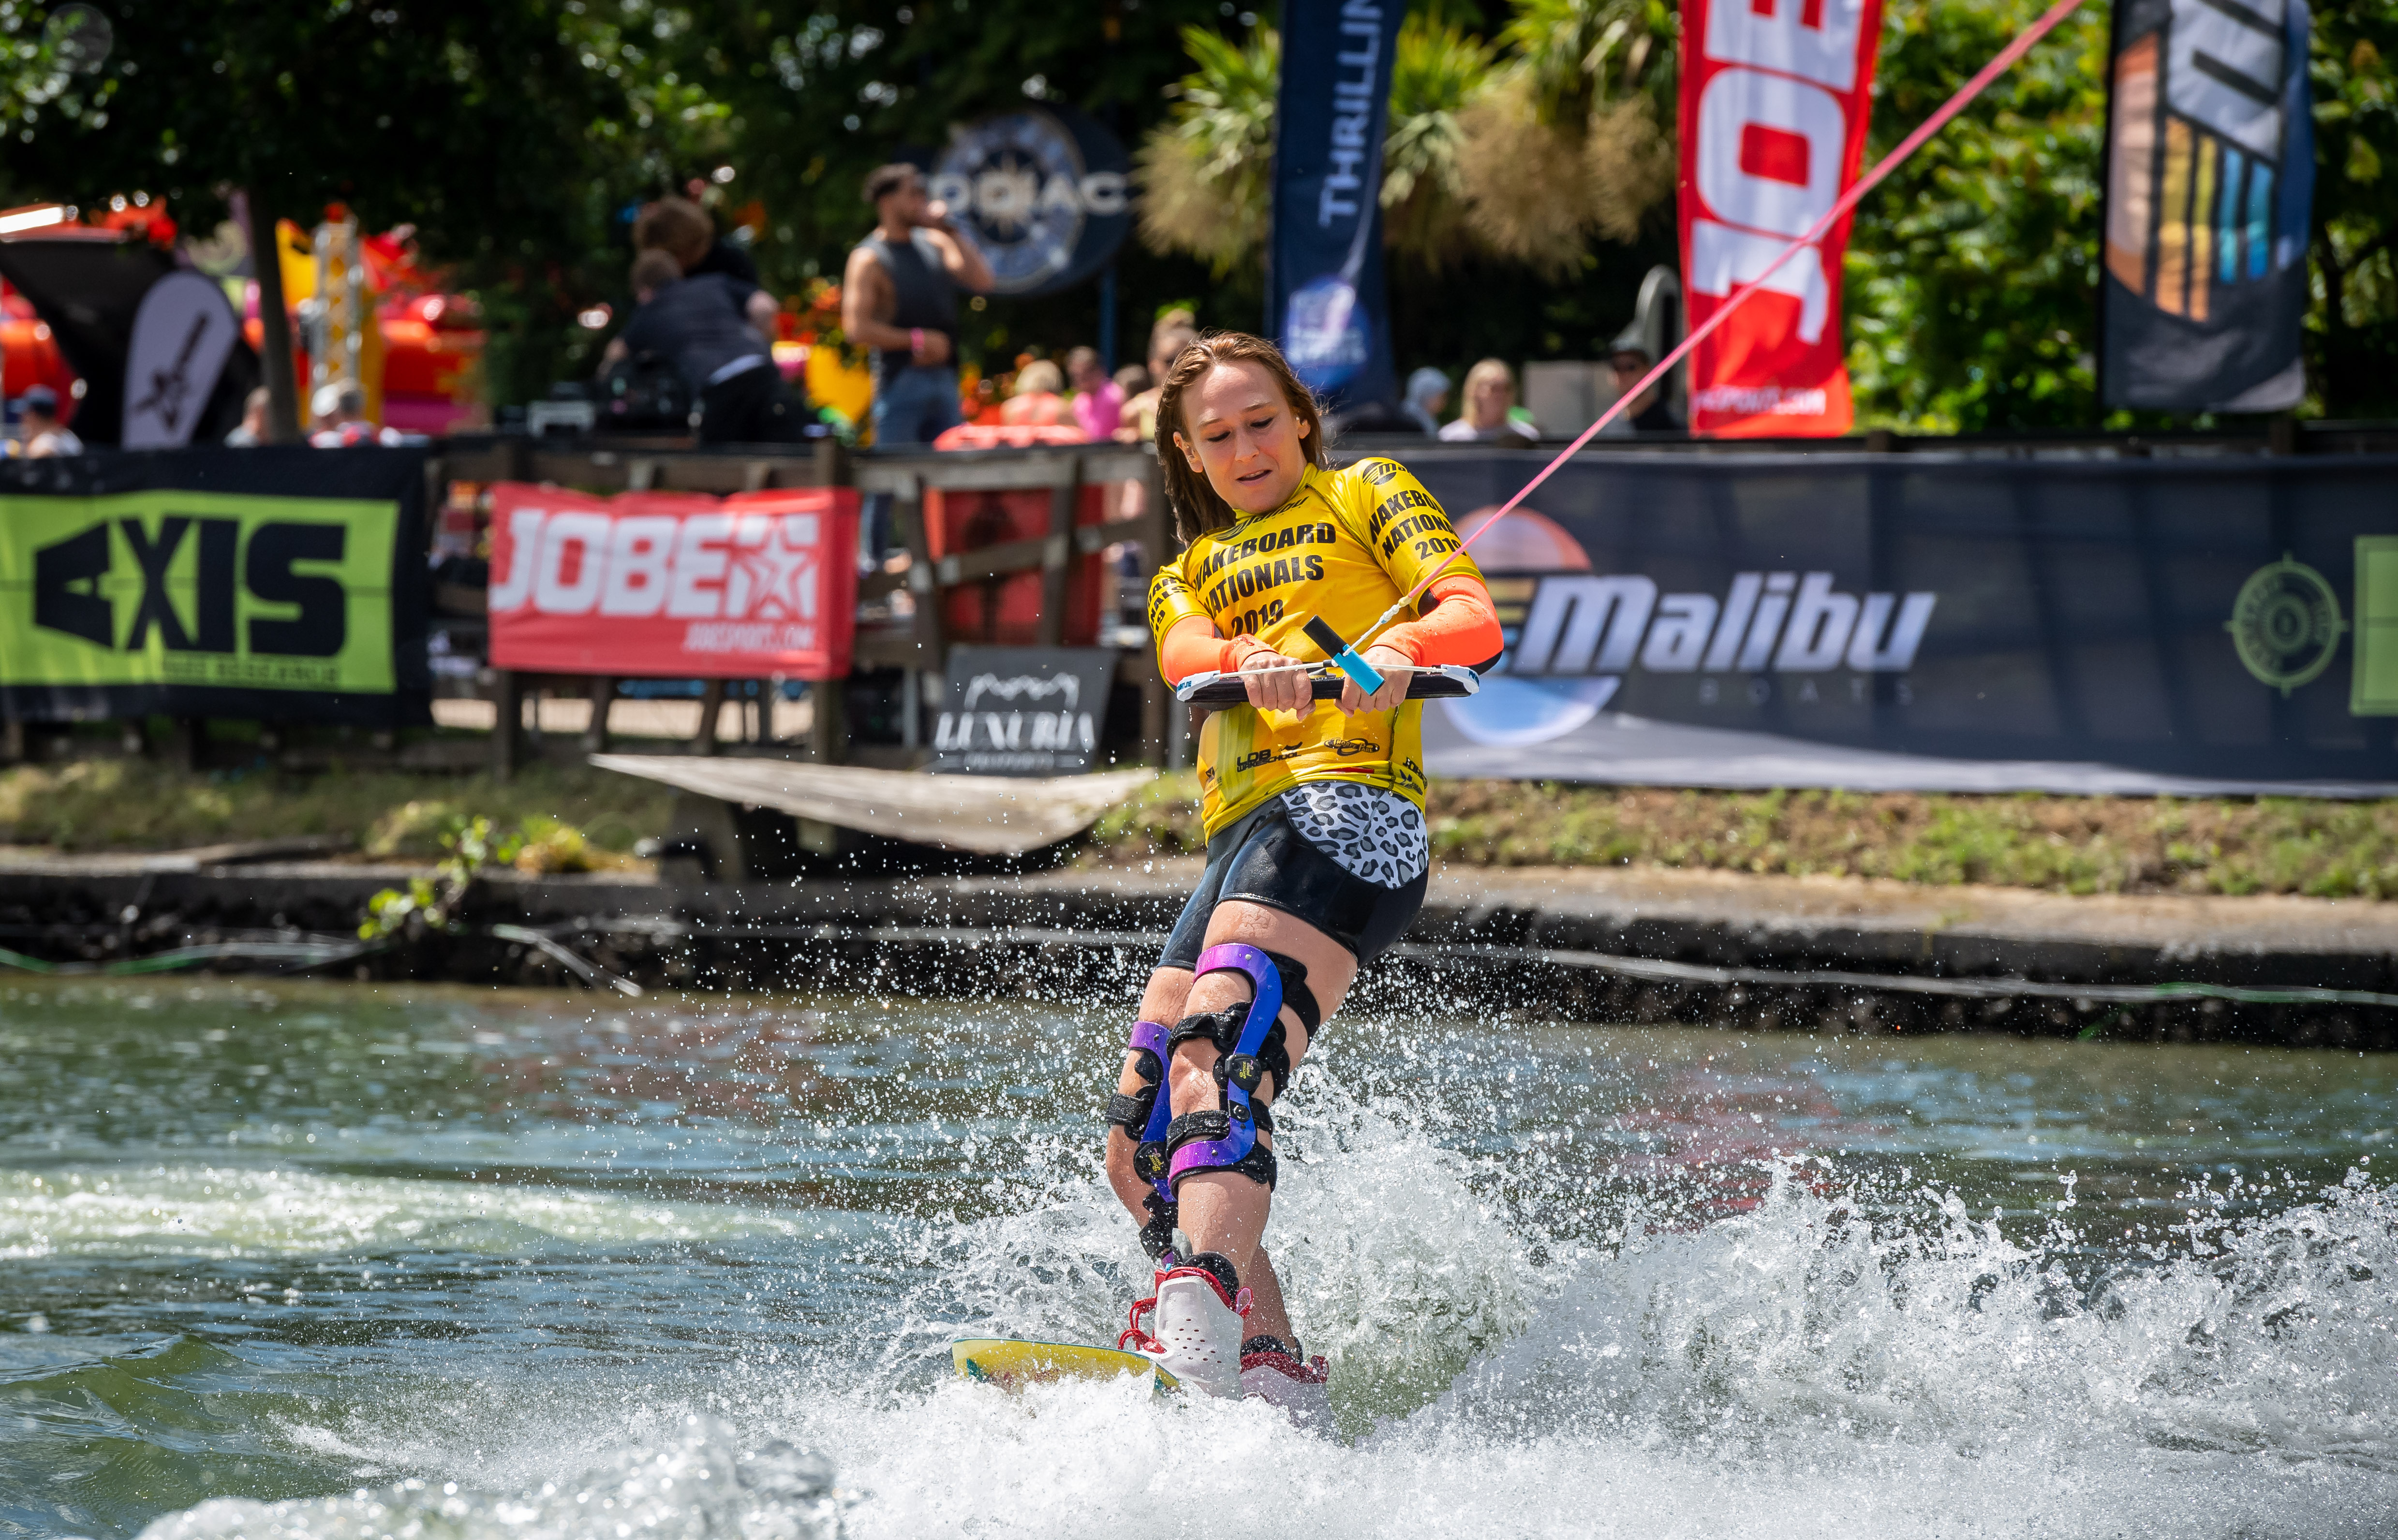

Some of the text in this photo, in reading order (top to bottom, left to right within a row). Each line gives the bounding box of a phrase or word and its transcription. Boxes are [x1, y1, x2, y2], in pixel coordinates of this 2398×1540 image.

[926, 171, 1129, 217] ODIAC
[34, 515, 347, 658] AXIS
[489, 508, 735, 618] JOBE
[1203, 555, 1324, 621] NATIONALS
[1231, 599, 1284, 638] 2019
[1698, 677, 1915, 707] BOATS
